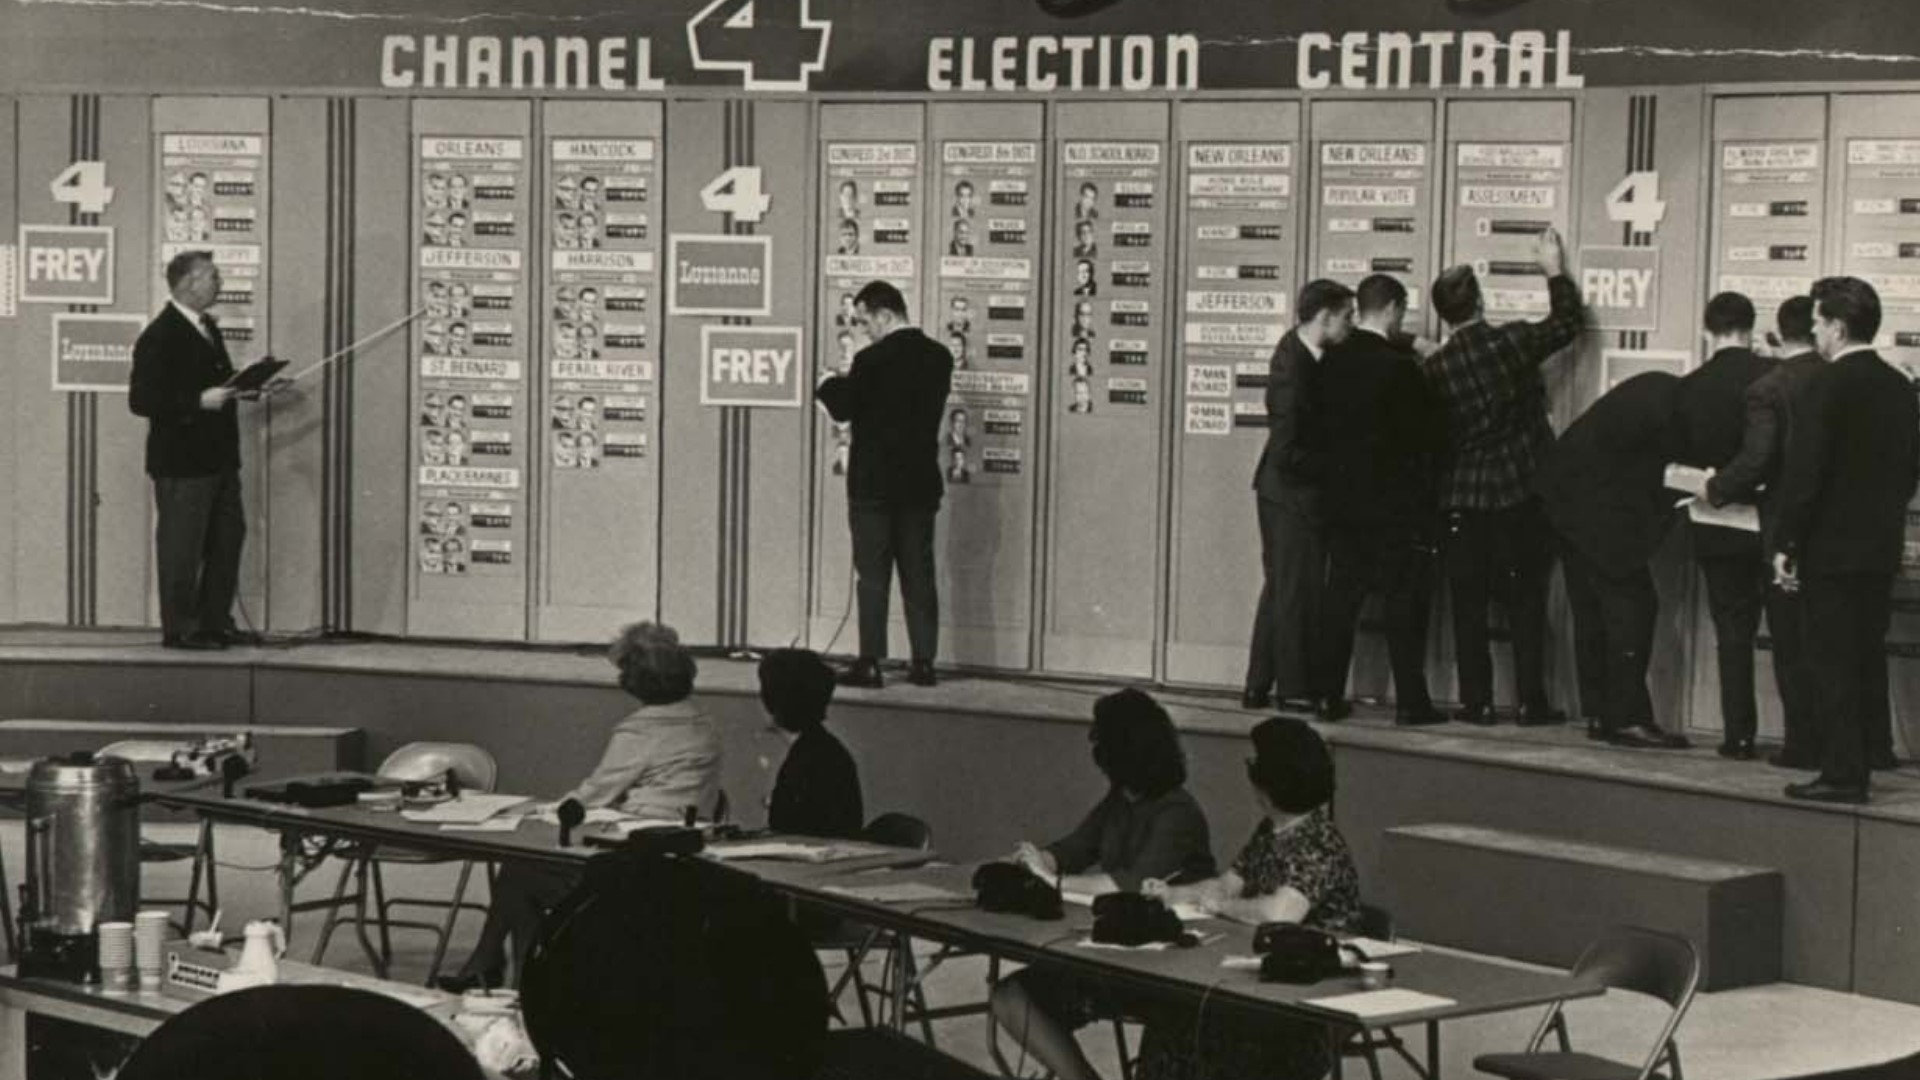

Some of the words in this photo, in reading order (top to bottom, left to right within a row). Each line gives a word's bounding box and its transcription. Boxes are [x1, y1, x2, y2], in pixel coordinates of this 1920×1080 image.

[381, 35, 665, 90] CHANNEL
[687, 0, 831, 91] 4
[926, 34, 1199, 91] ELECTION
[1297, 30, 1585, 90] CENTRAL
[436, 141, 503, 155] ORLEANS
[570, 143, 636, 156] HANCOCK
[1328, 147, 1355, 161] NEW
[1358, 147, 1418, 162] ORLEANS
[1194, 149, 1224, 163] NEW
[1228, 149, 1284, 163] ORLEANS
[51, 161, 115, 212] 4
[700, 166, 771, 222] 4
[1381, 189, 1410, 203] VOTE
[1606, 171, 1666, 232] 4
[29, 246, 104, 282] FREY
[424, 251, 512, 265] JEFFERSON
[568, 253, 634, 267] HARRISON
[1582, 267, 1653, 309] FREY
[1195, 294, 1275, 309] JEFFERSON
[450, 360, 507, 376] BERNARD
[557, 362, 599, 375] PEARL
[606, 363, 646, 376] RIVER
[711, 348, 793, 384] FREY
